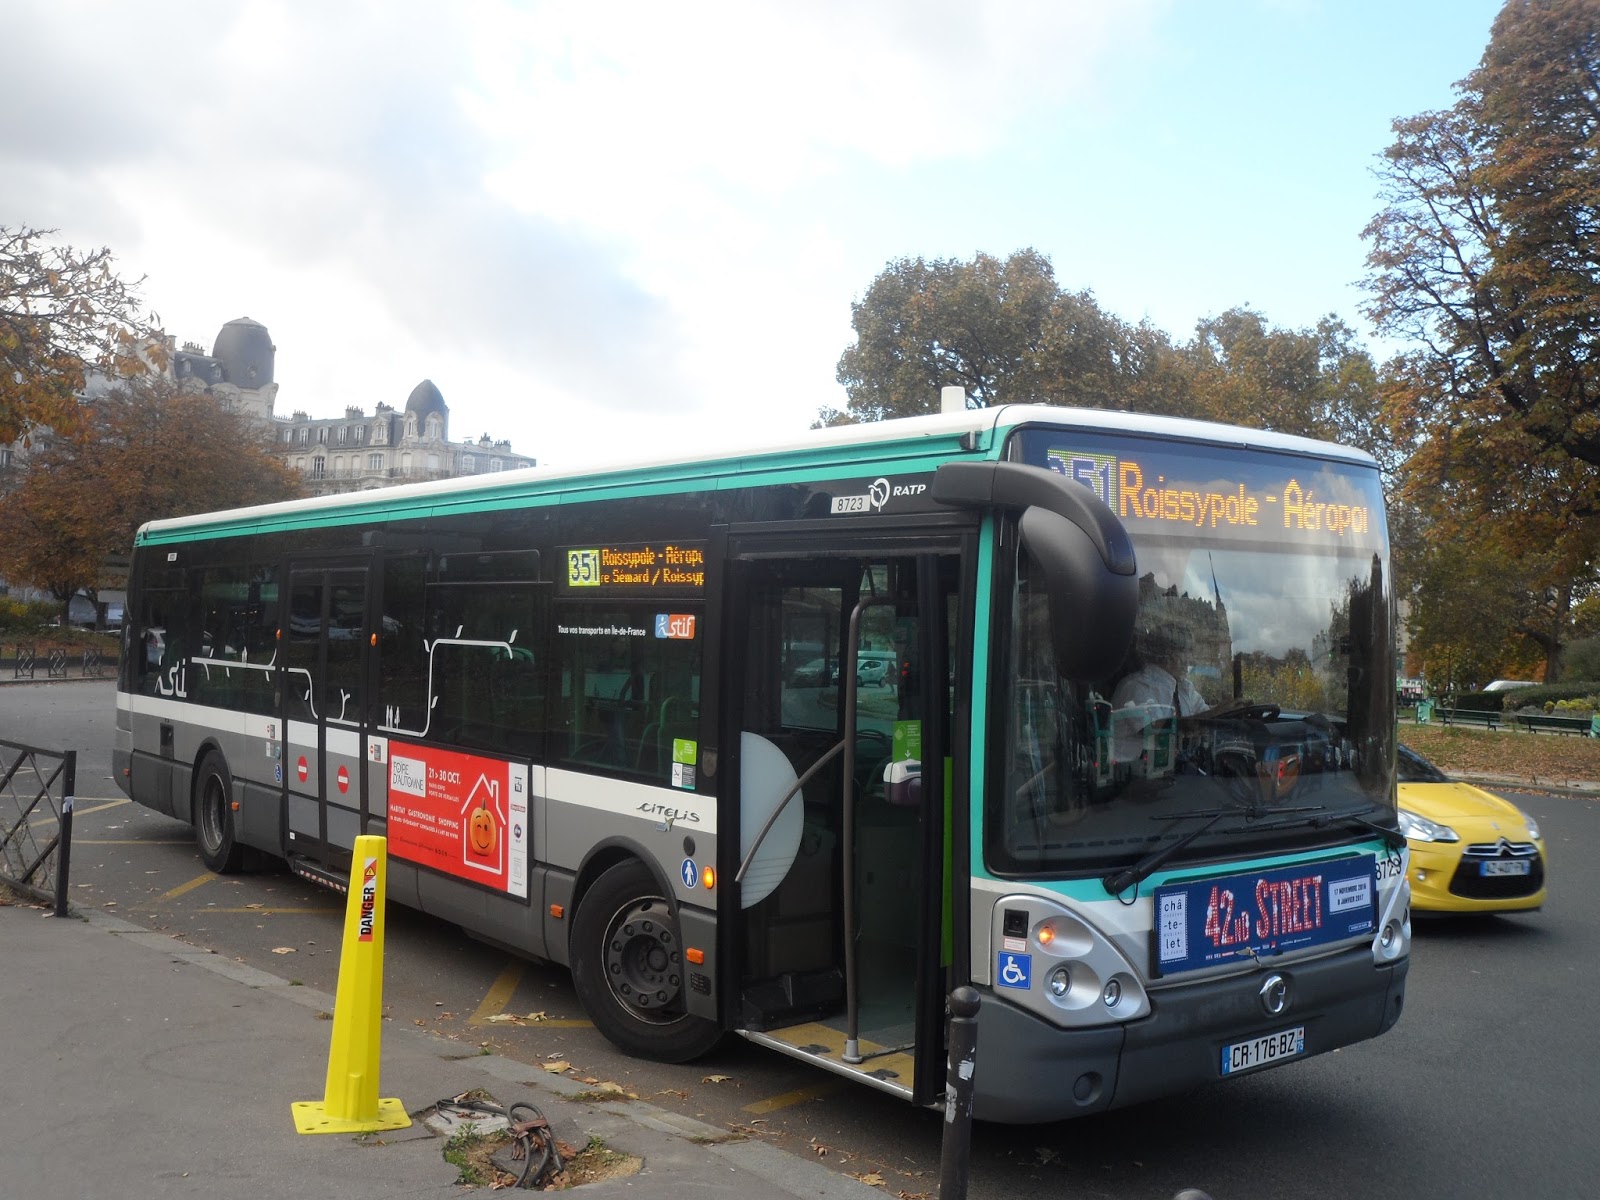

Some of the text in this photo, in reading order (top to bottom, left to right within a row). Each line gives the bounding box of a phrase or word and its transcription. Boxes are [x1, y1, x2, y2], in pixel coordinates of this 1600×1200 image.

[893, 484, 927, 497] RATP
[1119, 461, 1259, 528] Roissypole
[837, 497, 863, 512] 8723
[569, 552, 599, 582] 351
[602, 546, 655, 569] Roissypole
[612, 568, 649, 583] Sémard
[558, 625, 569, 634] Tous
[578, 626, 604, 636] transports
[428, 767, 435, 779] 21
[439, 769, 447, 782] 30
[447, 771, 461, 785] OCT.
[360, 887, 375, 935] DANGER
[1164, 898, 1182, 911] châ
[1256, 875, 1322, 939] STREET
[1166, 938, 1181, 949] let
[1296, 1040, 1304, 1051] 75
